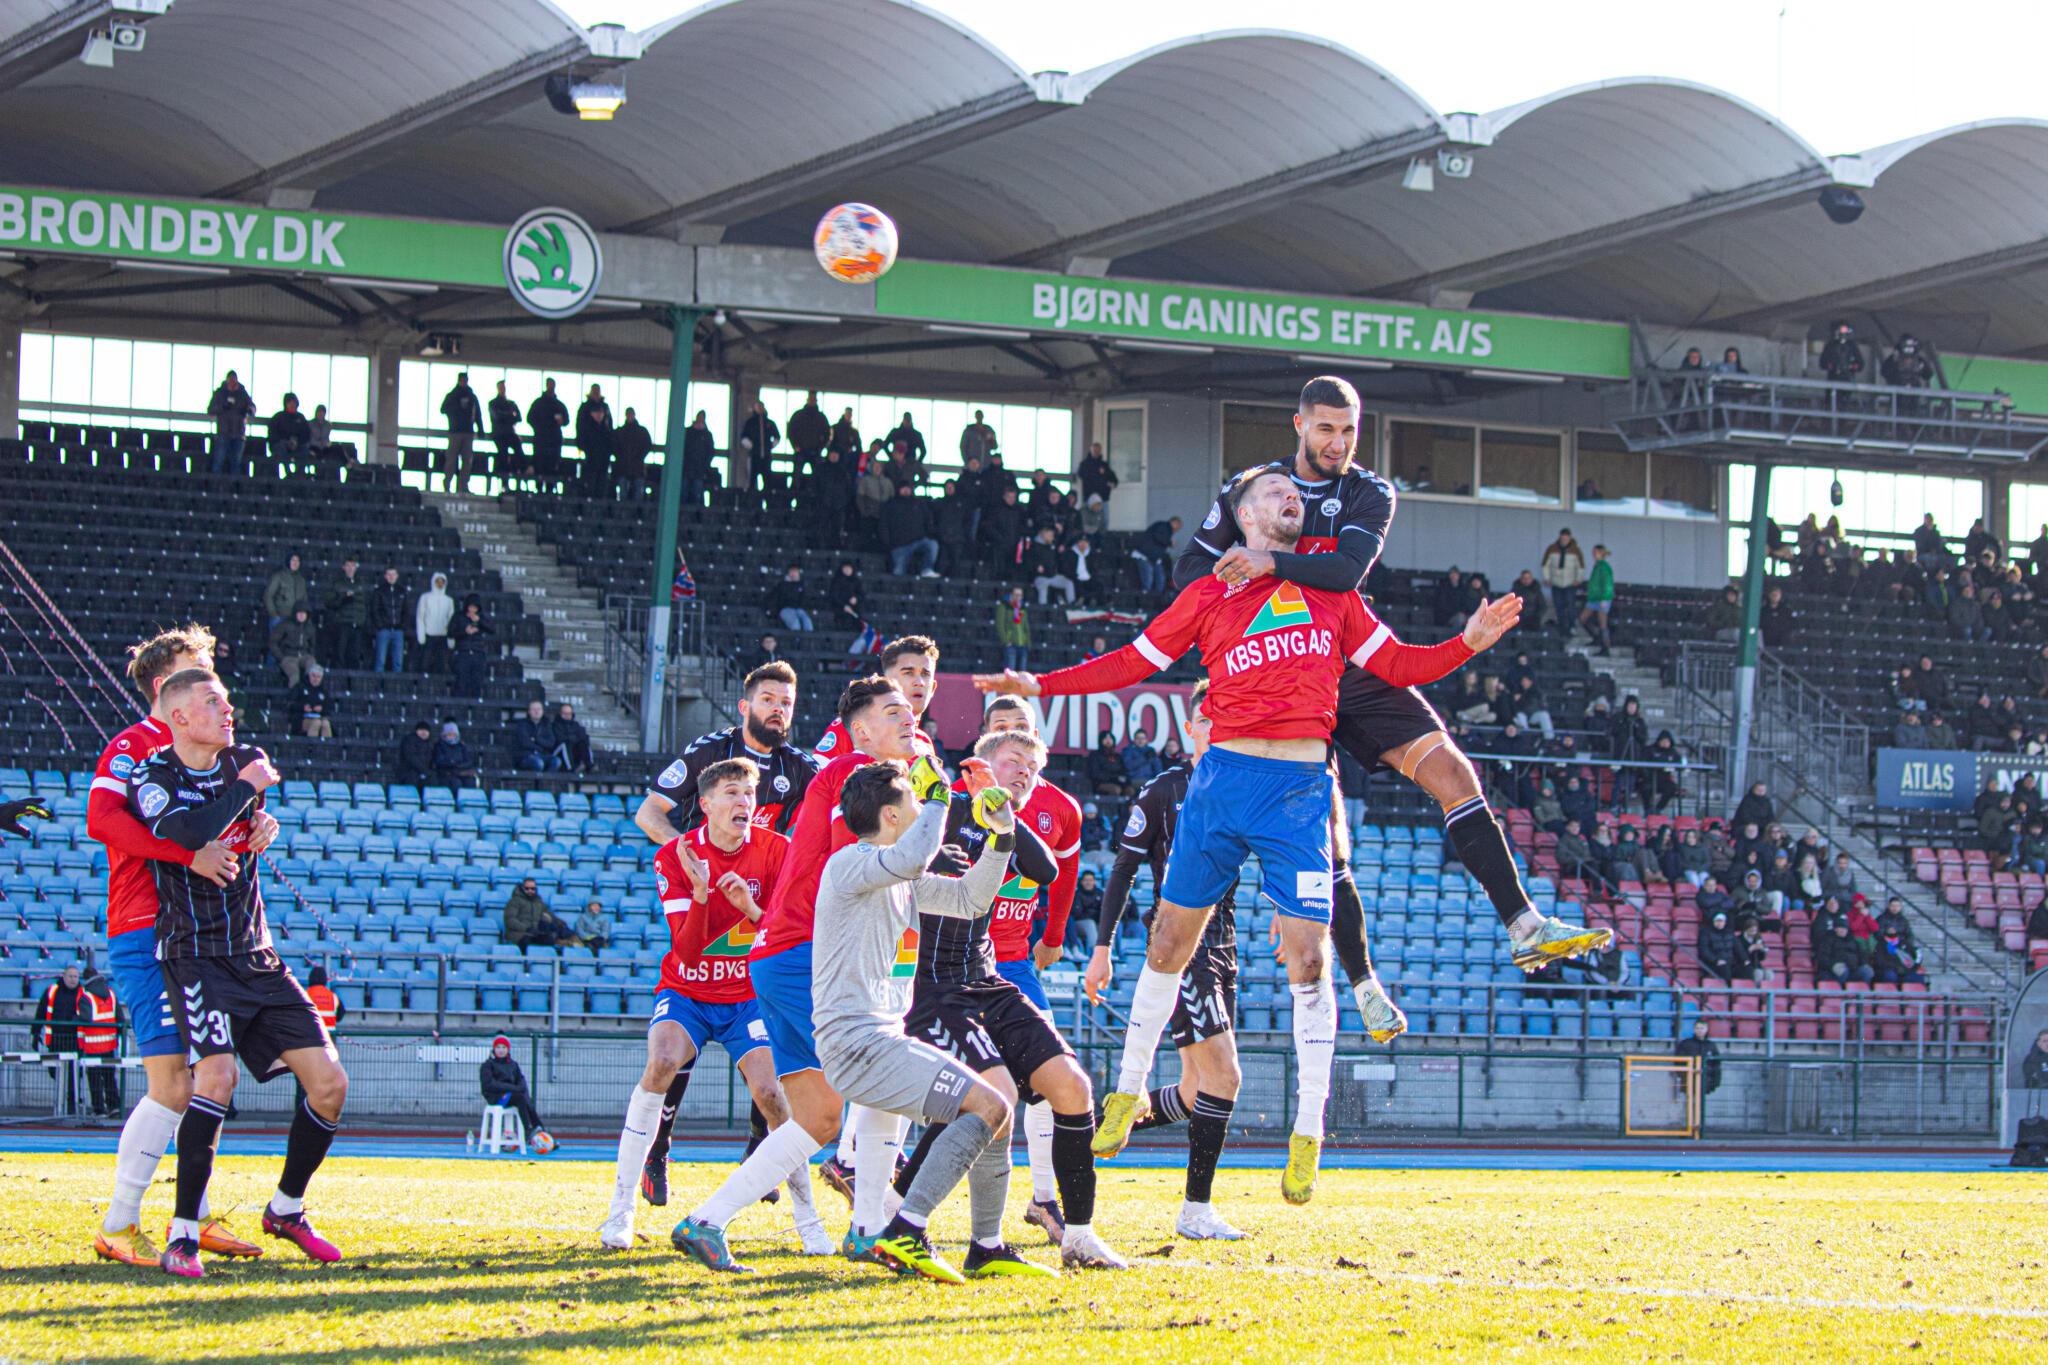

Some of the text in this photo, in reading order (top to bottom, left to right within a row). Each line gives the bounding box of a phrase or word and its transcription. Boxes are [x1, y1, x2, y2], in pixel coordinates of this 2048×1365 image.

[0, 194, 346, 268] BRONDBY.DK
[1033, 283, 1493, 357] BJØRN CANINGS EFTF. A/S
[1225, 629, 1333, 677] KBS BYG A/S
[1900, 761, 1954, 791] ATLAS
[996, 900, 1028, 921] BYG
[712, 960, 747, 981] BYG
[966, 1026, 1000, 1060] 18
